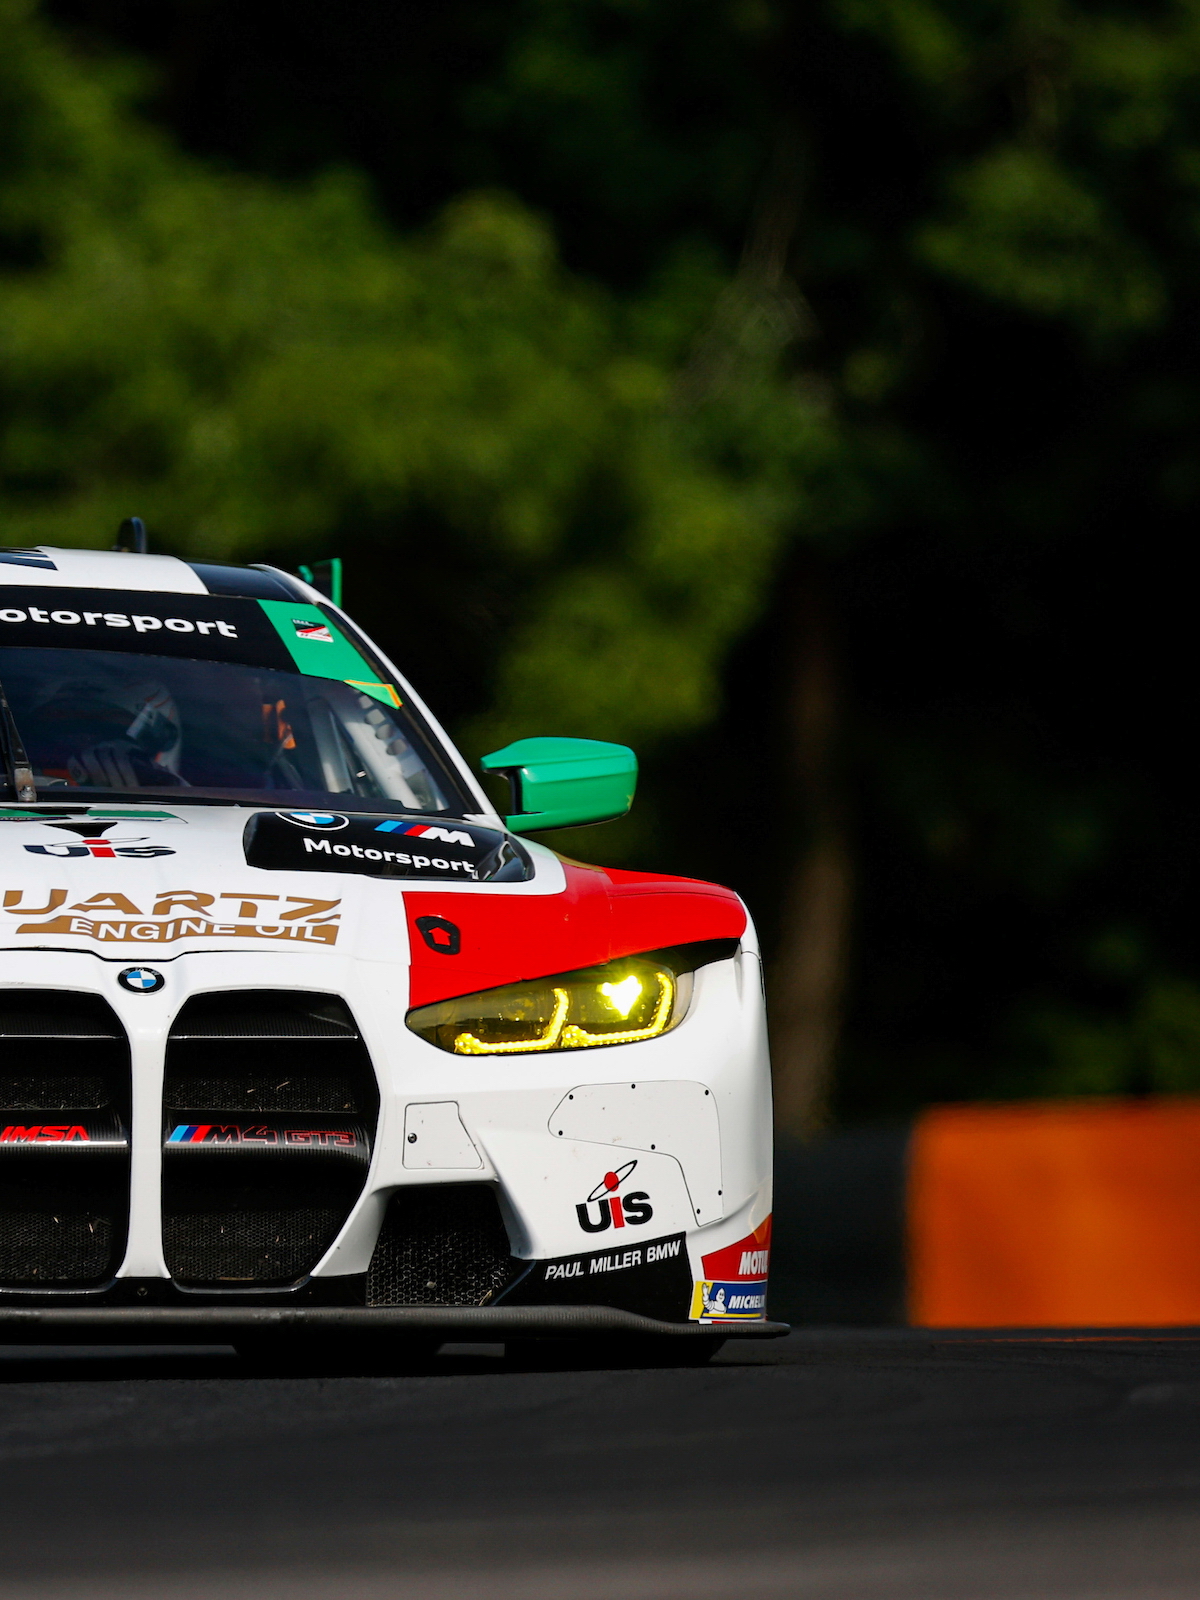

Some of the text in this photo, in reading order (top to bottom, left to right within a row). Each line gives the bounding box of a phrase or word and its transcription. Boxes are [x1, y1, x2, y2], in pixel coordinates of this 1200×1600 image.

[418, 826, 476, 848] M
[303, 837, 475, 874] Motorsport
[69, 917, 327, 942] ENGINE OIL
[283, 1130, 357, 1148] GT3
[544, 1239, 681, 1280] PAUL MILLER BMW
